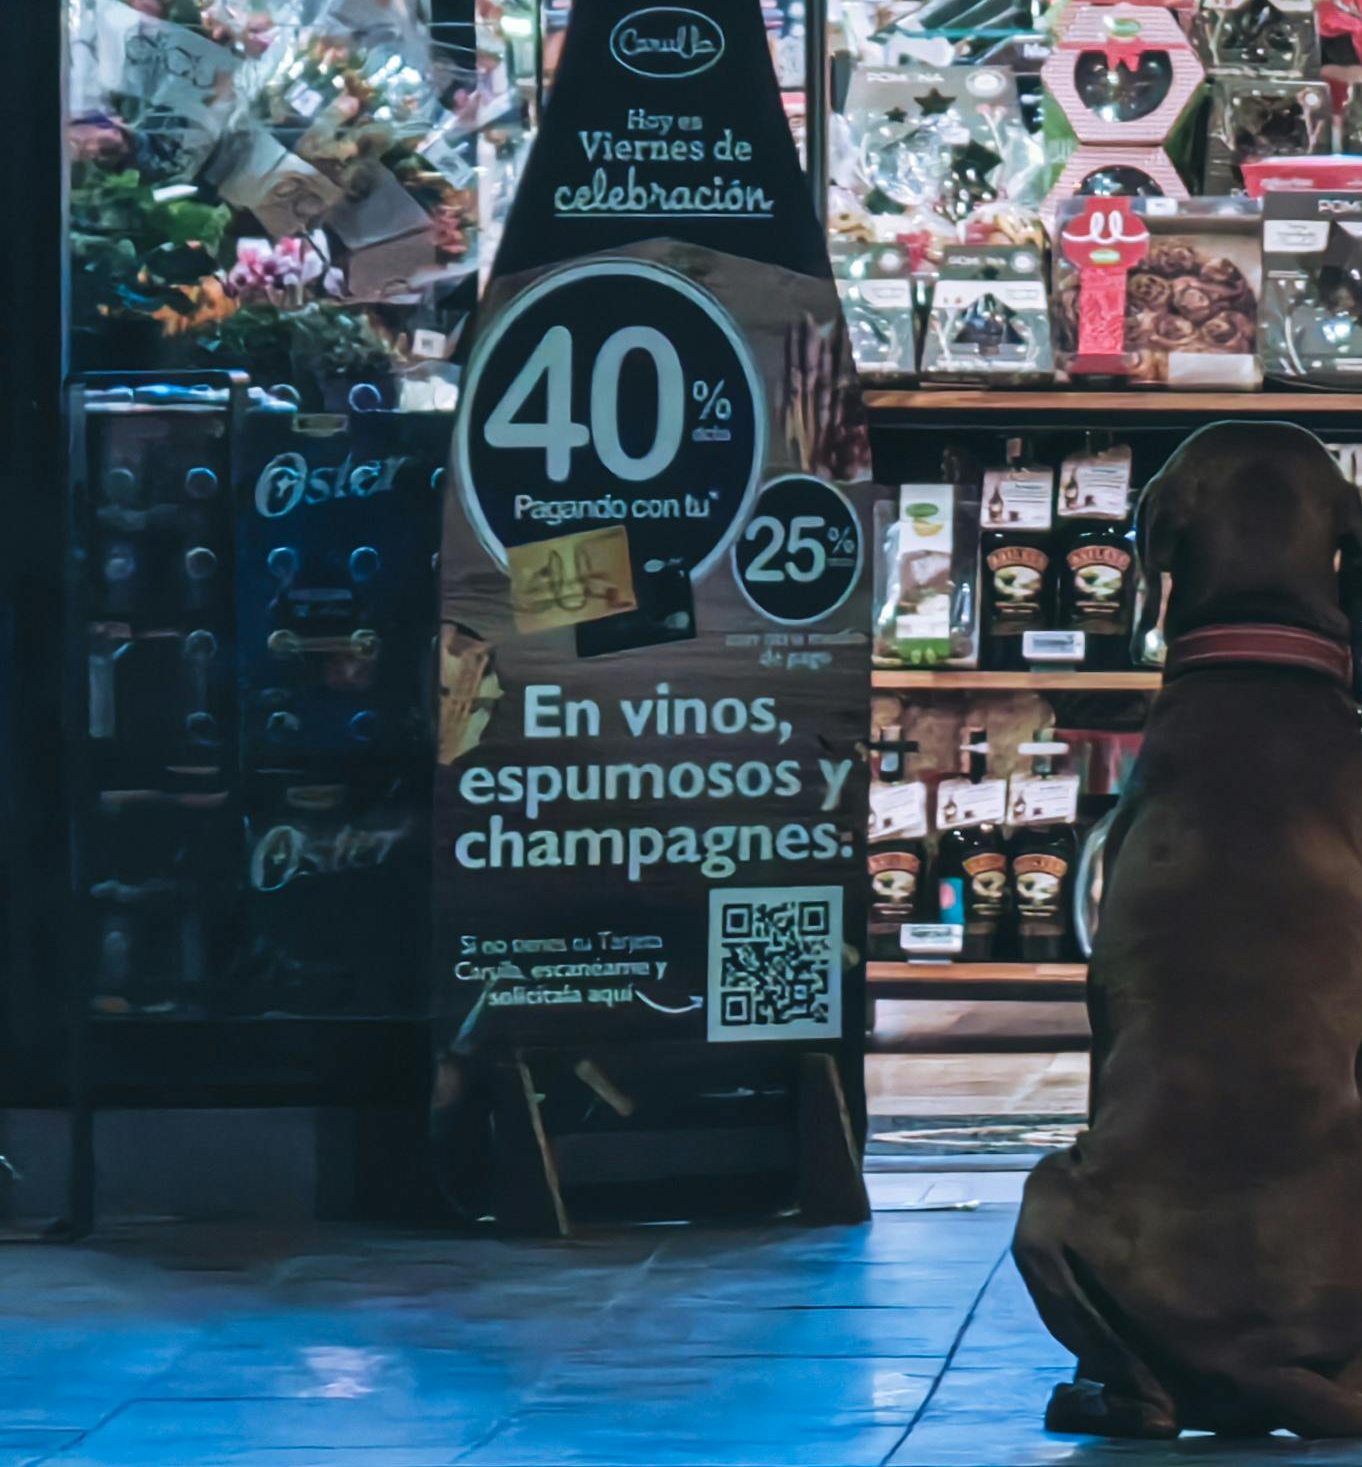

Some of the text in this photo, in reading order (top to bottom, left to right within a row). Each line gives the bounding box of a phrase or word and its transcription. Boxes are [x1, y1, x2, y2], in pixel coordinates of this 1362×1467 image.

[578, 129, 753, 162] Viernes de
[554, 165, 775, 211] celebración
[483, 325, 733, 482] 40%
[254, 451, 412, 518] Oster
[514, 493, 628, 526] Pagando
[631, 499, 681, 519] con
[745, 515, 856, 582] 25%
[523, 681, 793, 745] En vinos,
[458, 758, 854, 820] espumosos y
[454, 815, 854, 882] champagnes.
